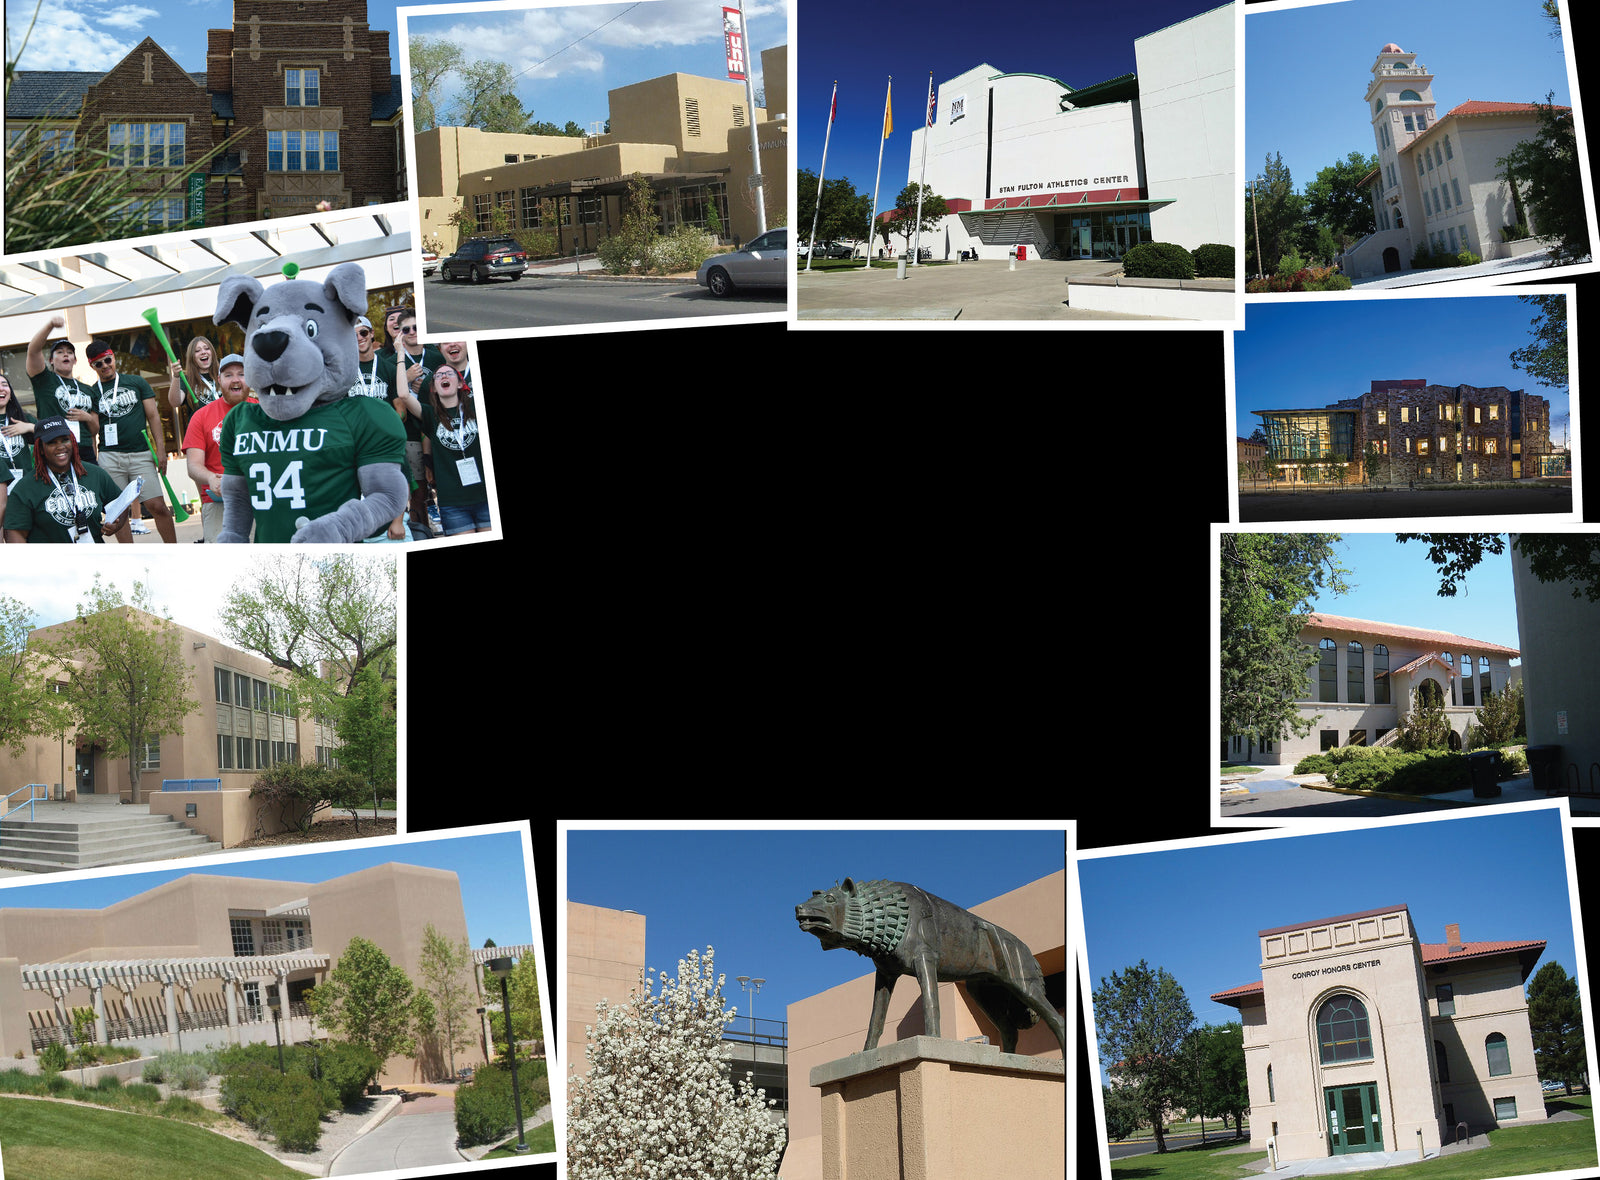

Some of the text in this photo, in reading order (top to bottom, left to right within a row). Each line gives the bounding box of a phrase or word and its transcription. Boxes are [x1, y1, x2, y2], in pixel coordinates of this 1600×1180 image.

[748, 139, 786, 152] CMMUN
[999, 175, 1129, 194] STAN FULTON ATHLETICS CENTER
[271, 195, 338, 203] ADMINISTRATION
[232, 428, 328, 456] ENMU
[249, 460, 306, 510] 34
[1292, 959, 1381, 980] CONROY HONORS CENTER
